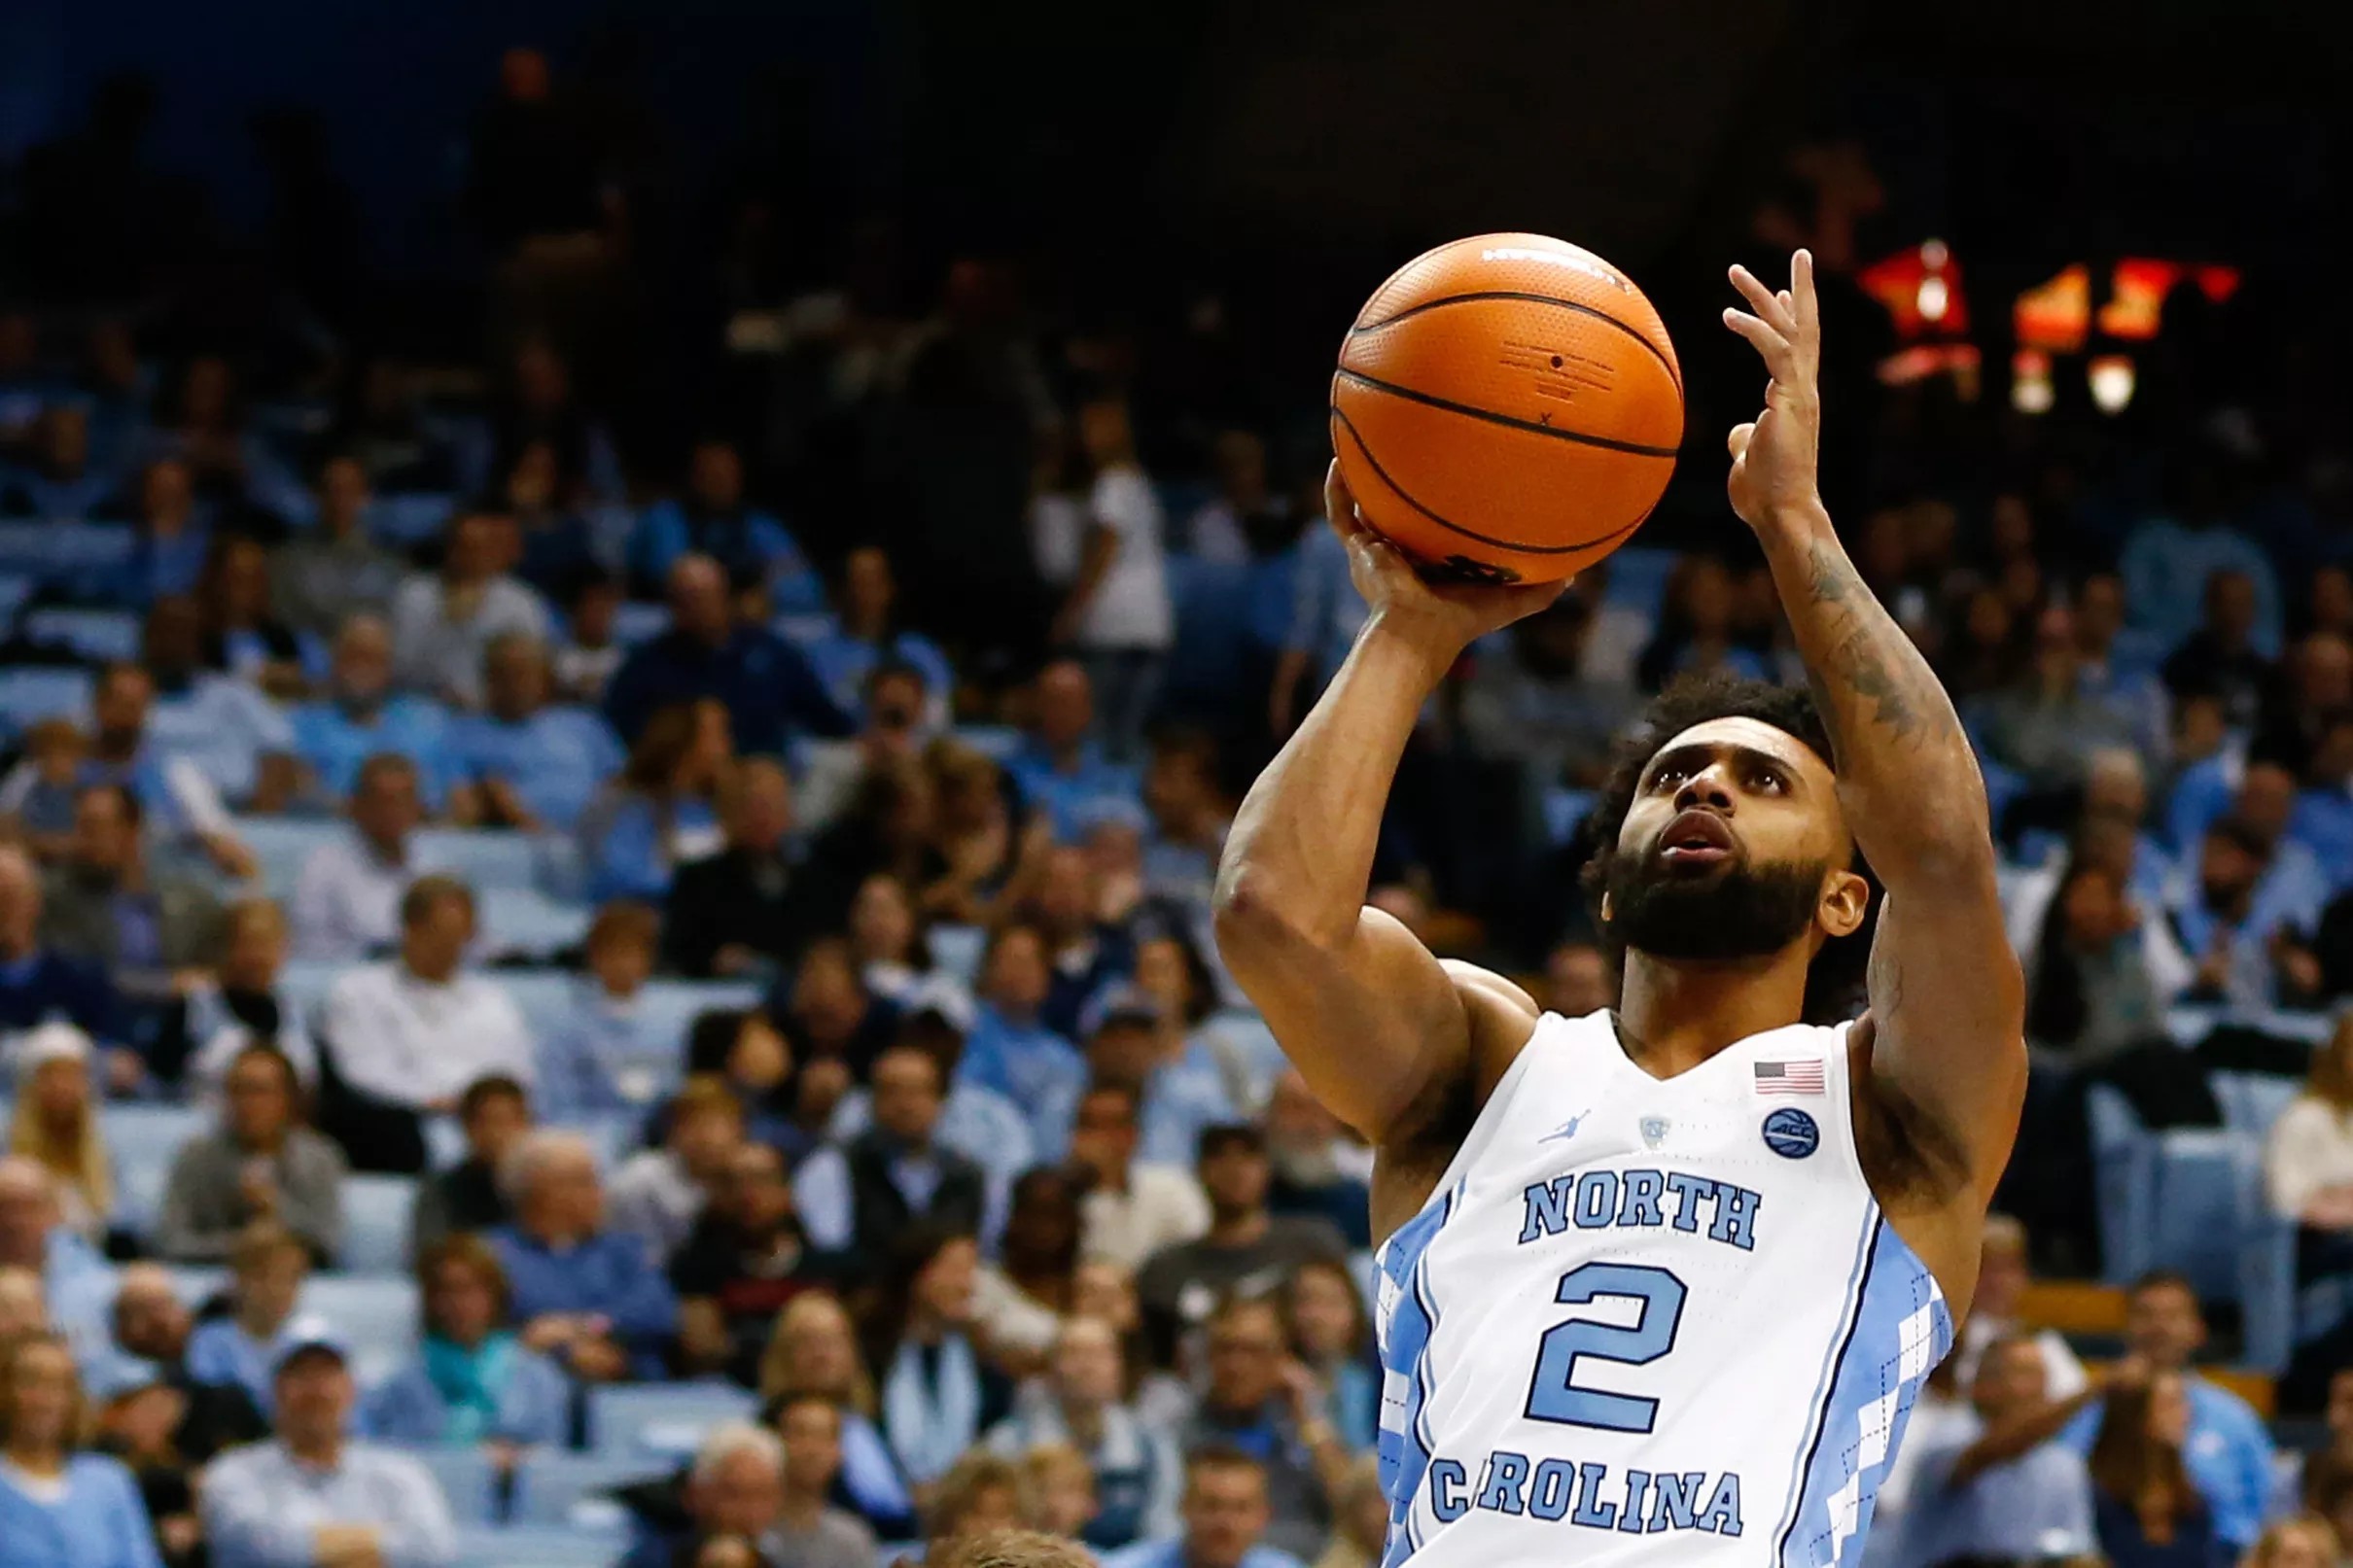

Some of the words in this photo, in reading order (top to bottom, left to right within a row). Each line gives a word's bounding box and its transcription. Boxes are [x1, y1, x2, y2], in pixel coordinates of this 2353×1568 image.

[1770, 1123, 1813, 1140] ACC
[1519, 1168, 1761, 1252] NORTH
[1523, 1261, 1688, 1434] 2
[1429, 1450, 1743, 1537] CROLINA
